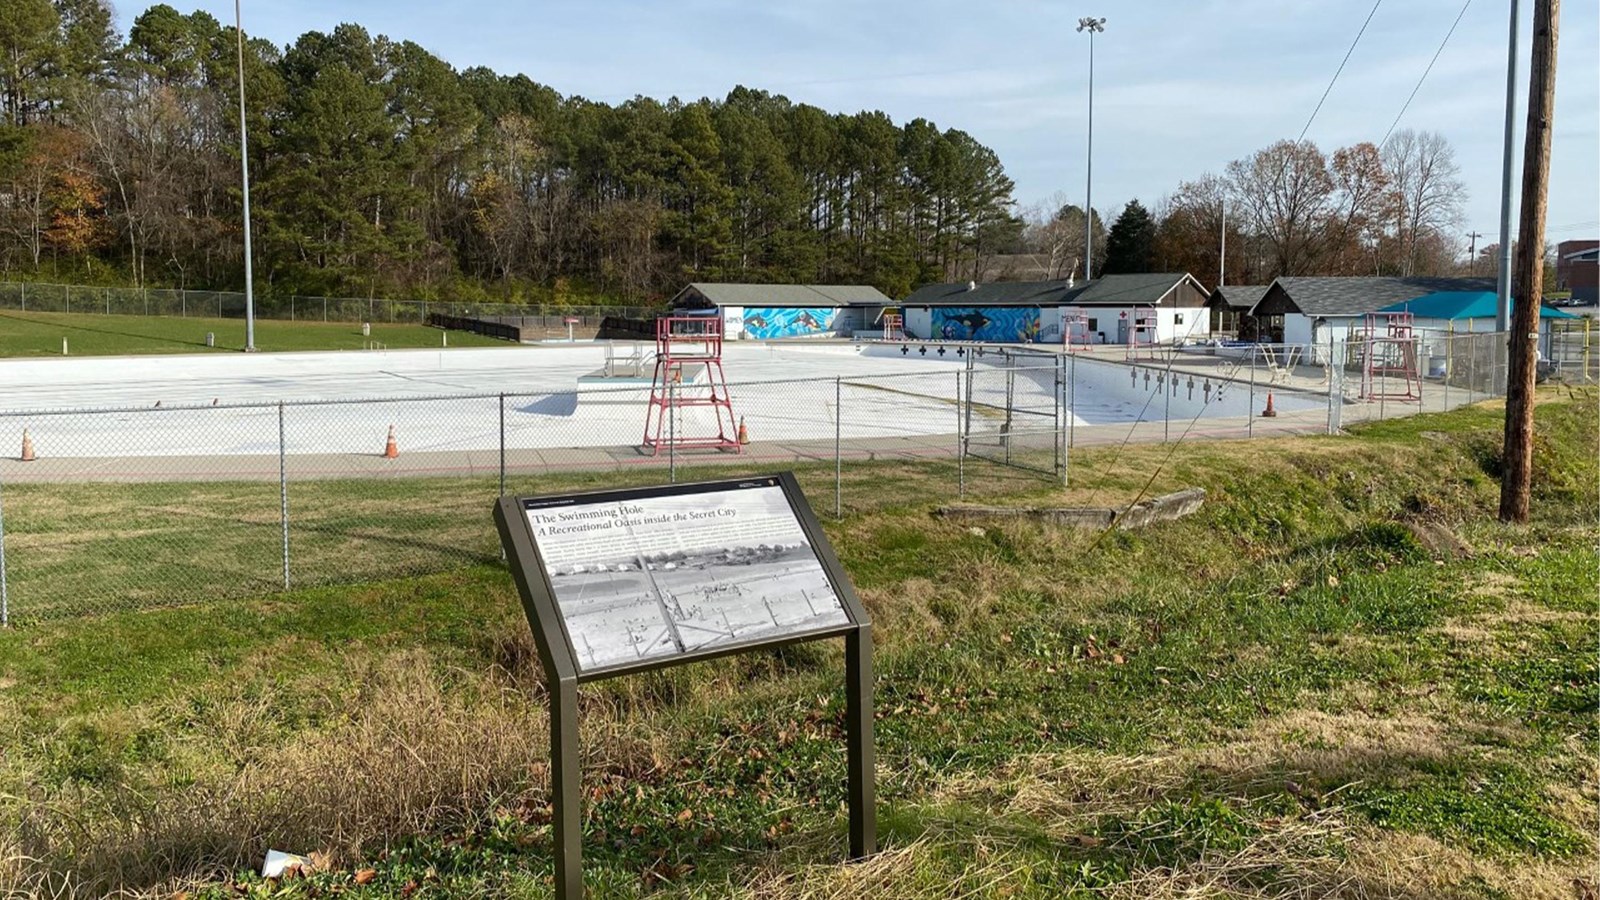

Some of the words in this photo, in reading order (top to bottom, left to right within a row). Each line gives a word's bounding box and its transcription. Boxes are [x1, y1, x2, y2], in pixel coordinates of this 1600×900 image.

[532, 513, 556, 525] The
[558, 508, 617, 522] Swimming
[618, 505, 644, 515] Hole
[538, 528, 546, 537] A
[549, 521, 612, 535] Recreational
[614, 517, 642, 528] Oasis
[644, 514, 671, 525] inside
[673, 512, 688, 522] the
[689, 509, 716, 520] Secret
[717, 506, 737, 518] City
